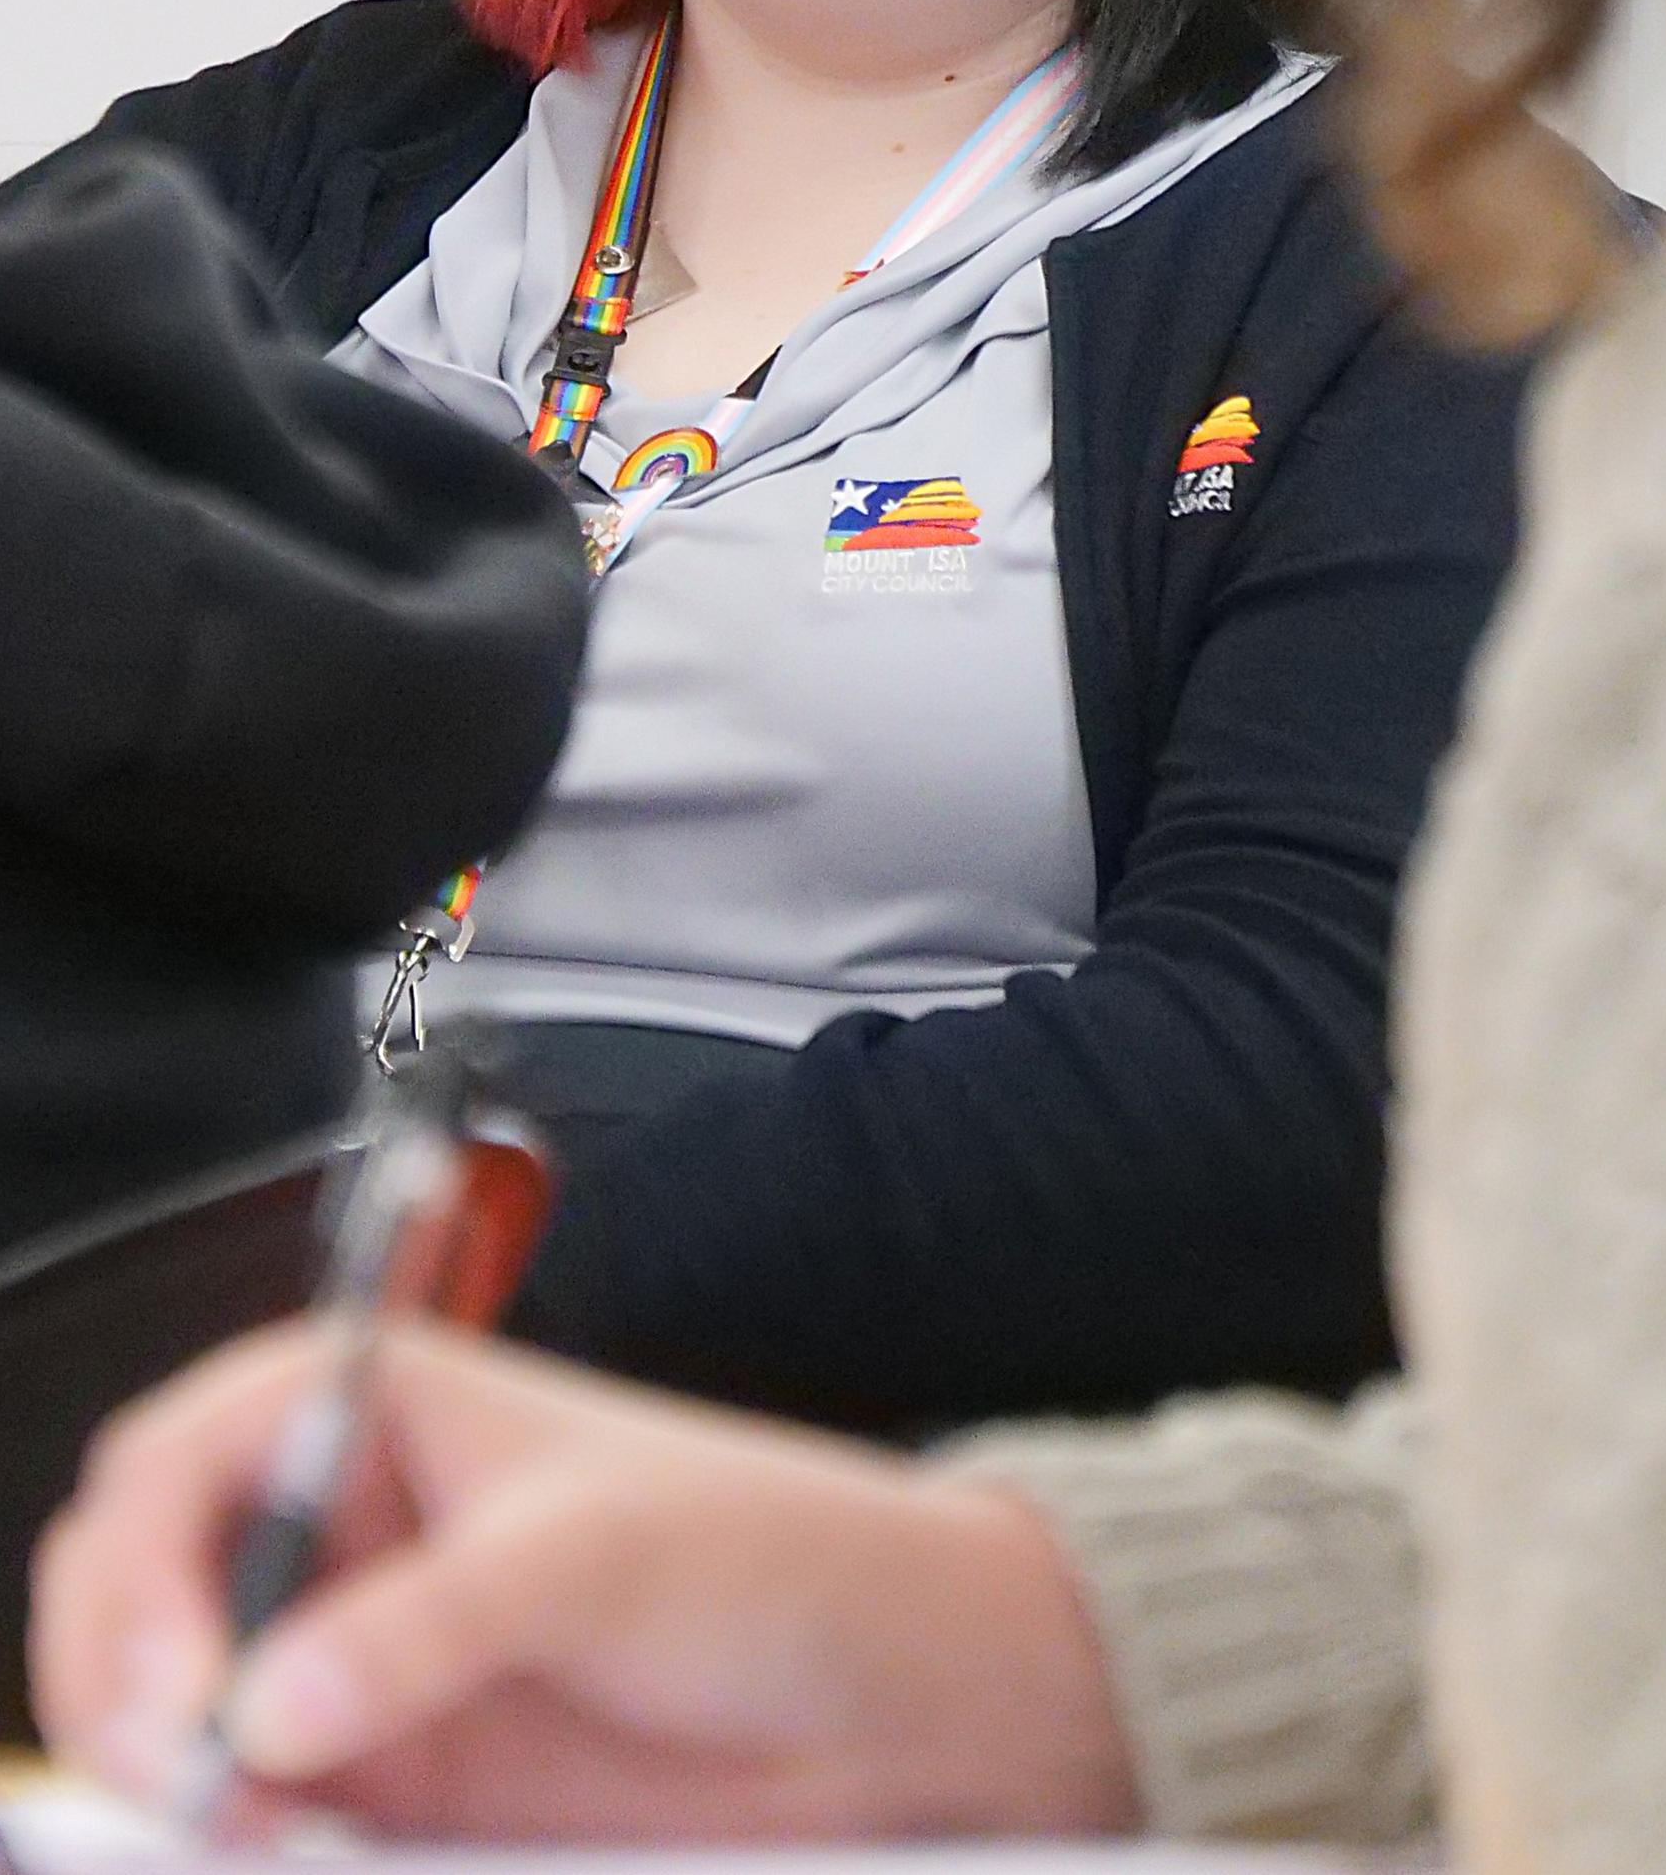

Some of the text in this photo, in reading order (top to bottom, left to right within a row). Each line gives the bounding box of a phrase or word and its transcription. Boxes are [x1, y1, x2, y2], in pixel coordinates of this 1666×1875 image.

[823, 546, 967, 574] MOUNT ISA
[821, 574, 974, 593] CITY COUNCIL
